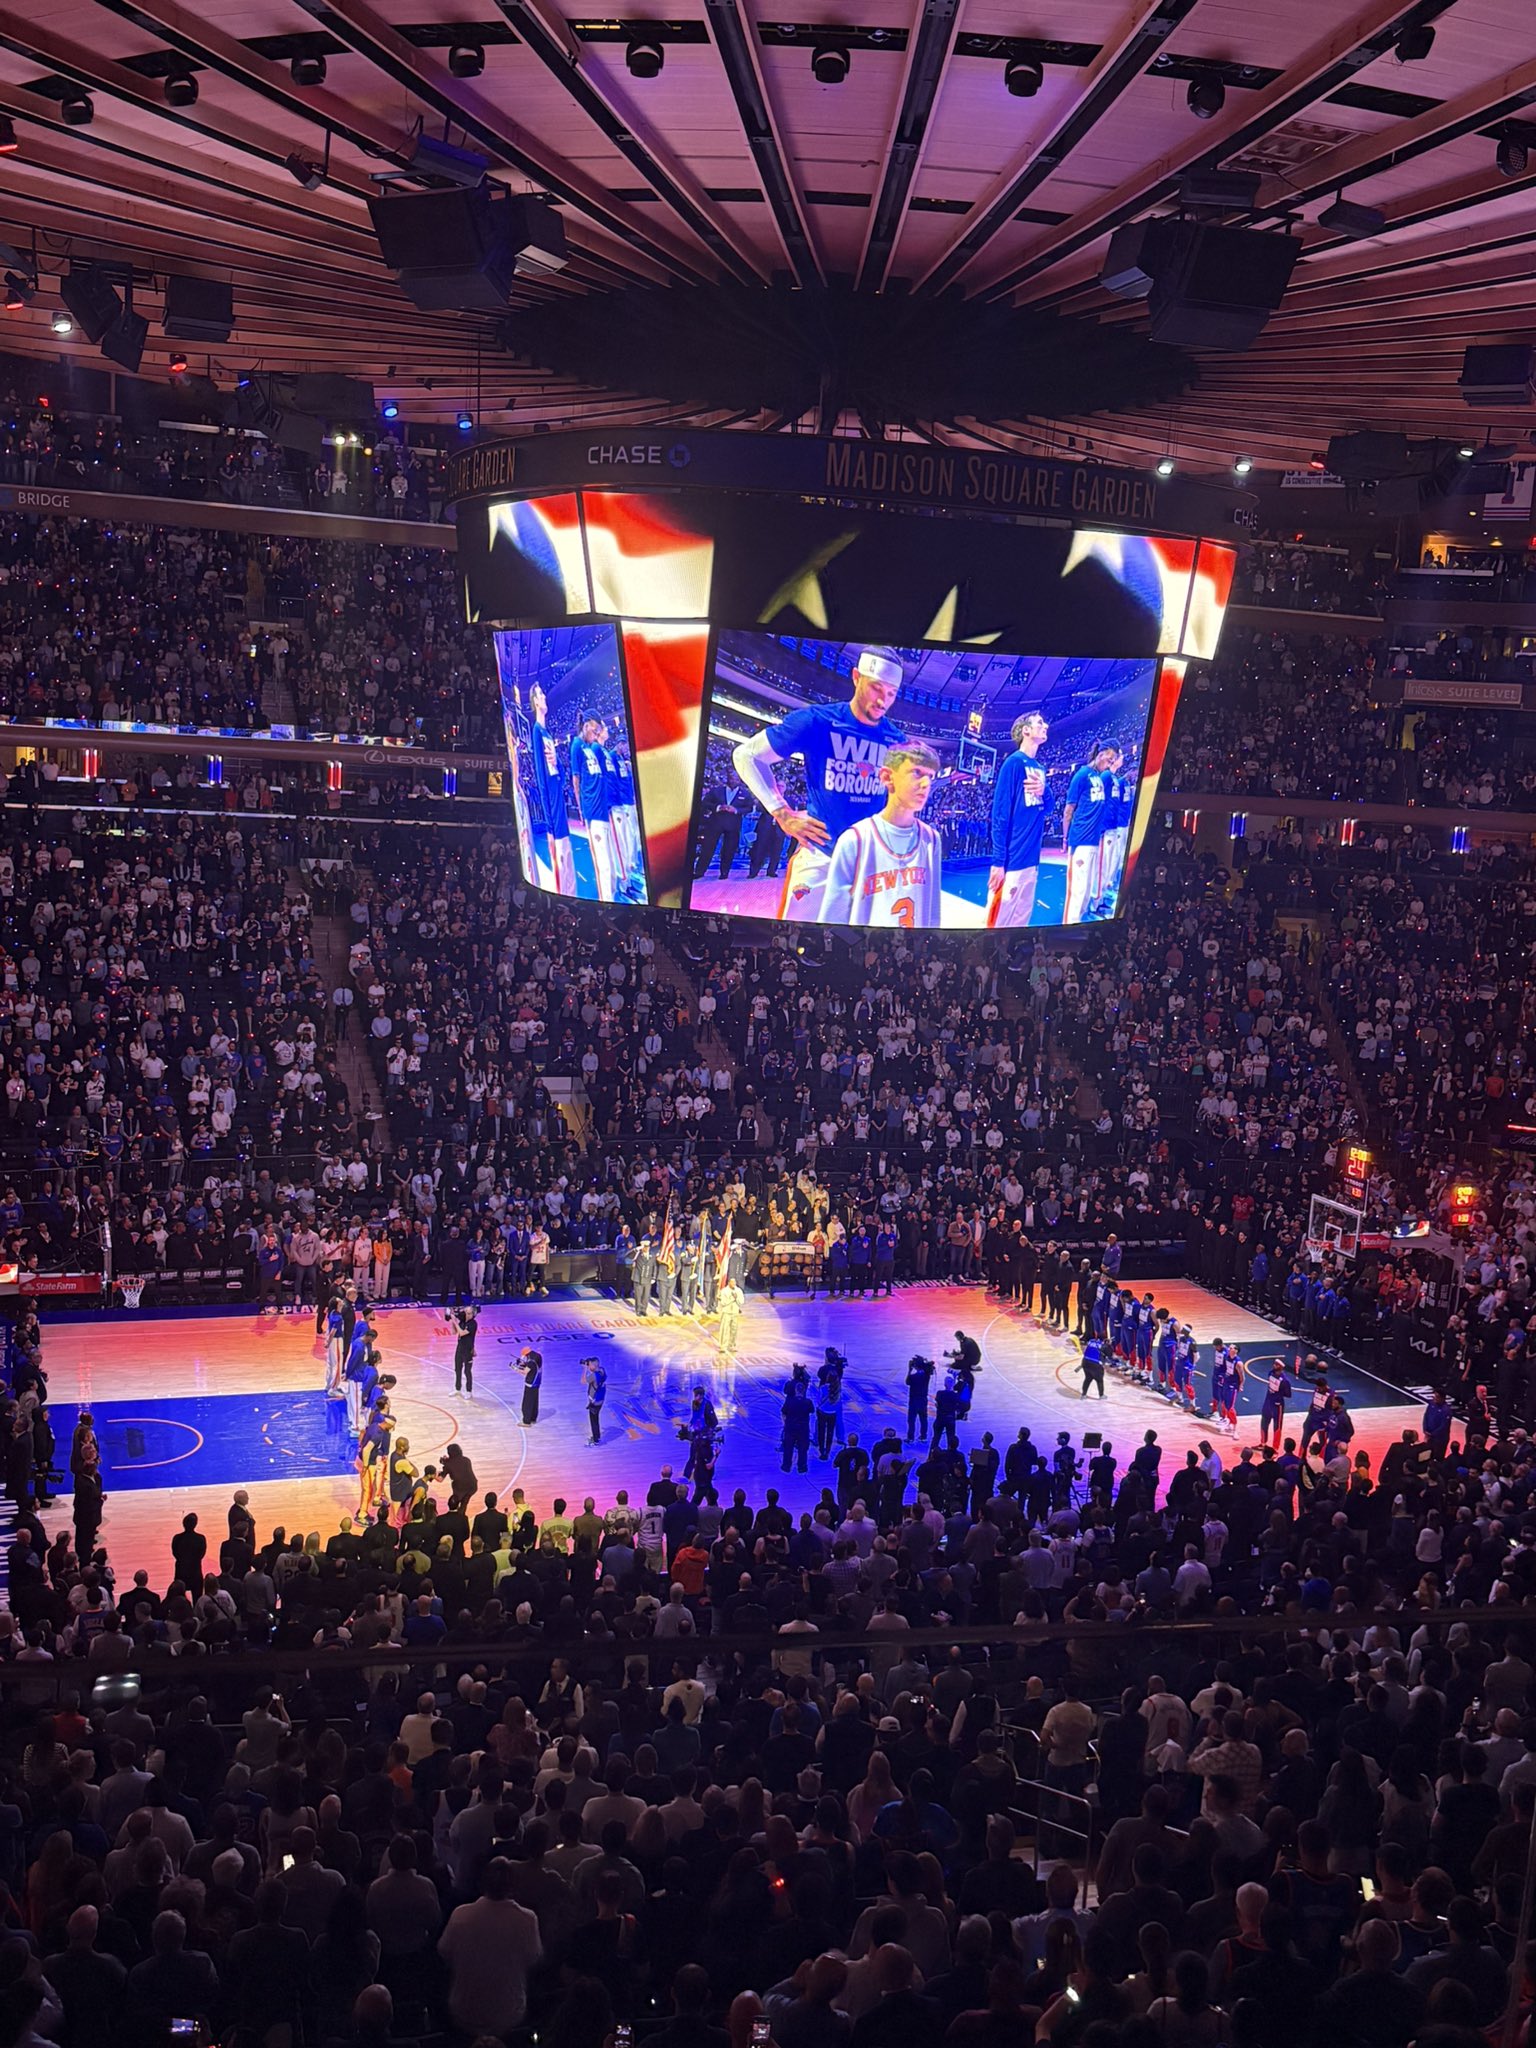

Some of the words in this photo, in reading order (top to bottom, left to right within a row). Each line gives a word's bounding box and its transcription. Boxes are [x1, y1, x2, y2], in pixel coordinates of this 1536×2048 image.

[587, 445, 663, 465] CHASE
[472, 447, 516, 489] GARDEN
[826, 443, 955, 497] MADISON
[963, 455, 1064, 508] SQUARE
[1071, 467, 1157, 520] GARDEN
[18, 491, 71, 508] BRIDGE
[1448, 687, 1480, 698] SUITE
[1483, 688, 1517, 700] LEVEL
[386, 755, 446, 766] LEXUS
[465, 759, 494, 770] SUITE
[826, 757, 857, 774] FOR
[863, 869, 899, 896] NEW
[891, 896, 915, 928] 3
[1347, 1157, 1365, 1179] 24
[366, 1301, 433, 1309] Google
[496, 1332, 588, 1345] CHASE
